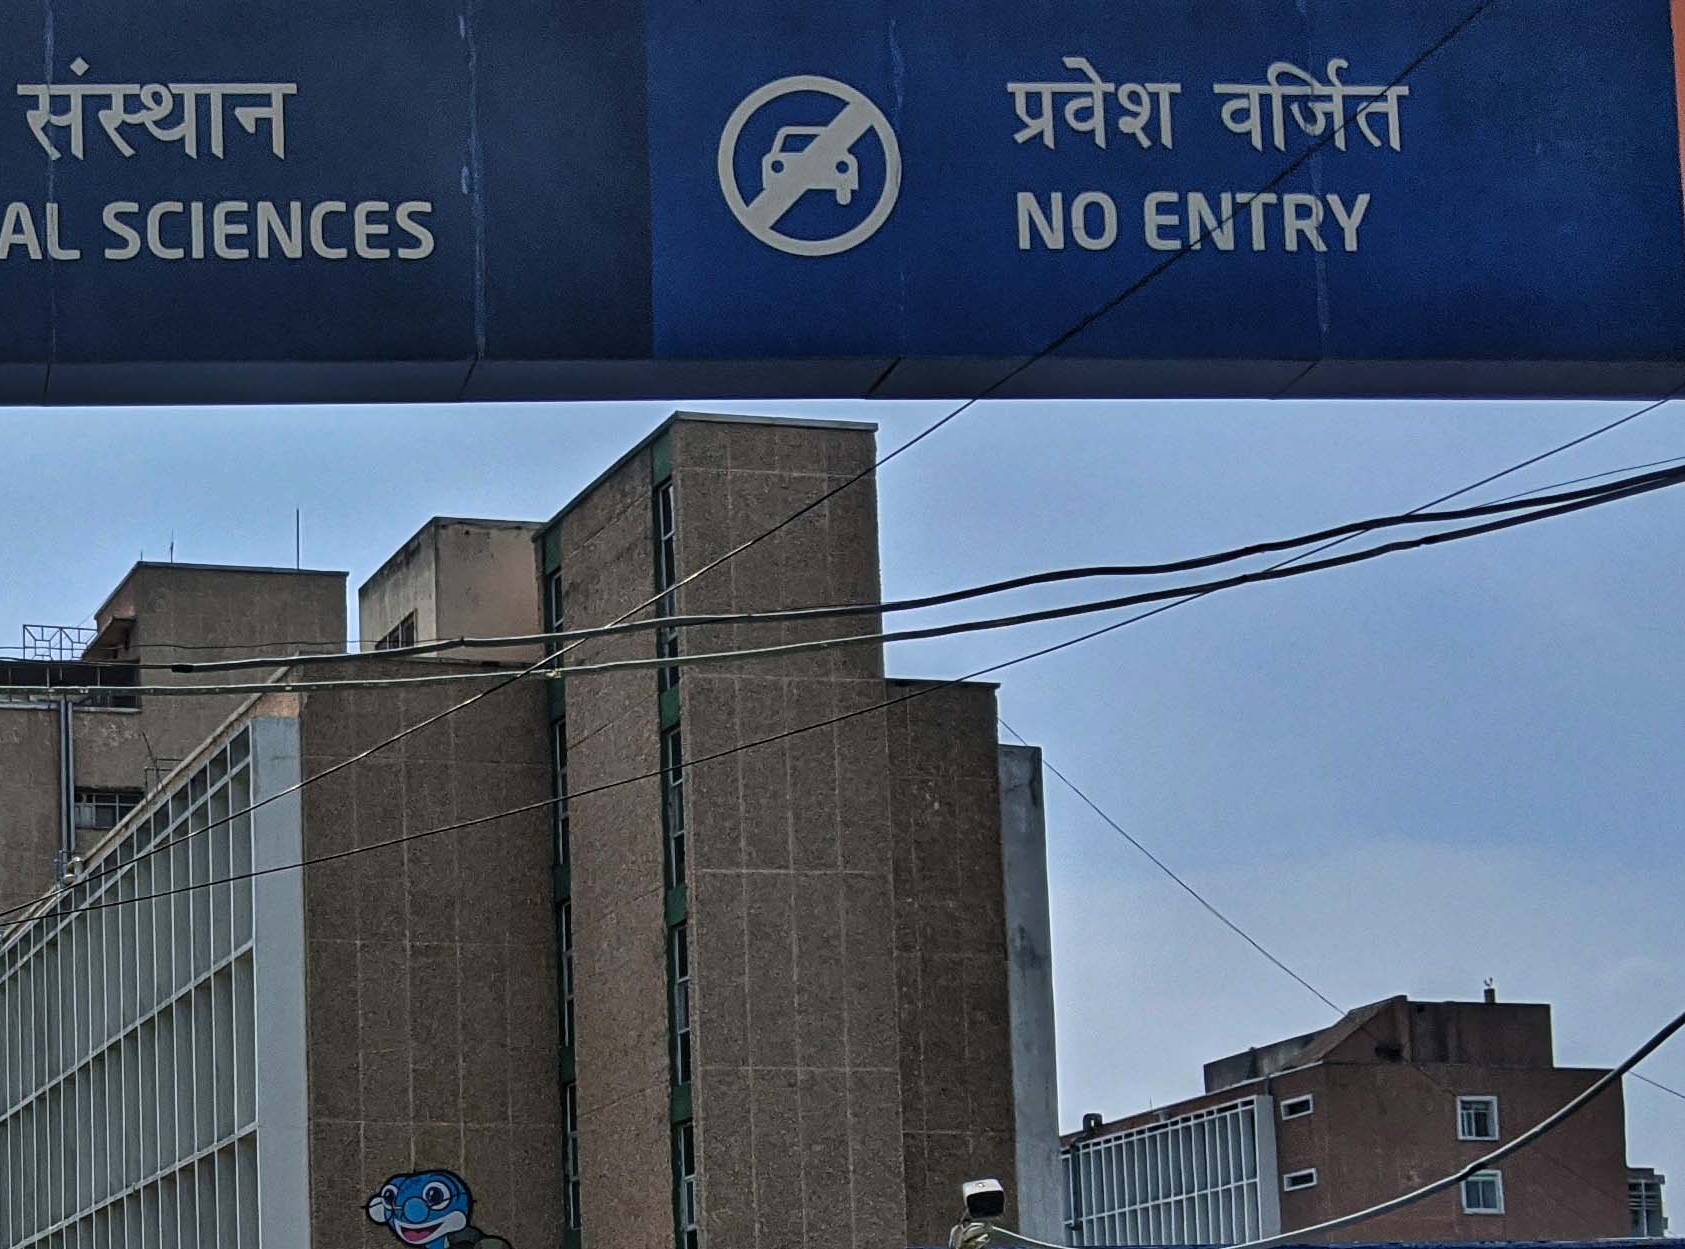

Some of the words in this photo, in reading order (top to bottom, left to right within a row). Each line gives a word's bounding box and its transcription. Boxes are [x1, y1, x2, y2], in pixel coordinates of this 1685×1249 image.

[17, 58, 297, 160] संस्थान
[1007, 56, 1181, 150] प्रवेश
[1213, 58, 1409, 152] वर्जित
[105, 200, 436, 260] SCIENCES
[1016, 191, 1118, 251] NO
[1144, 191, 1371, 252] ENTRY
